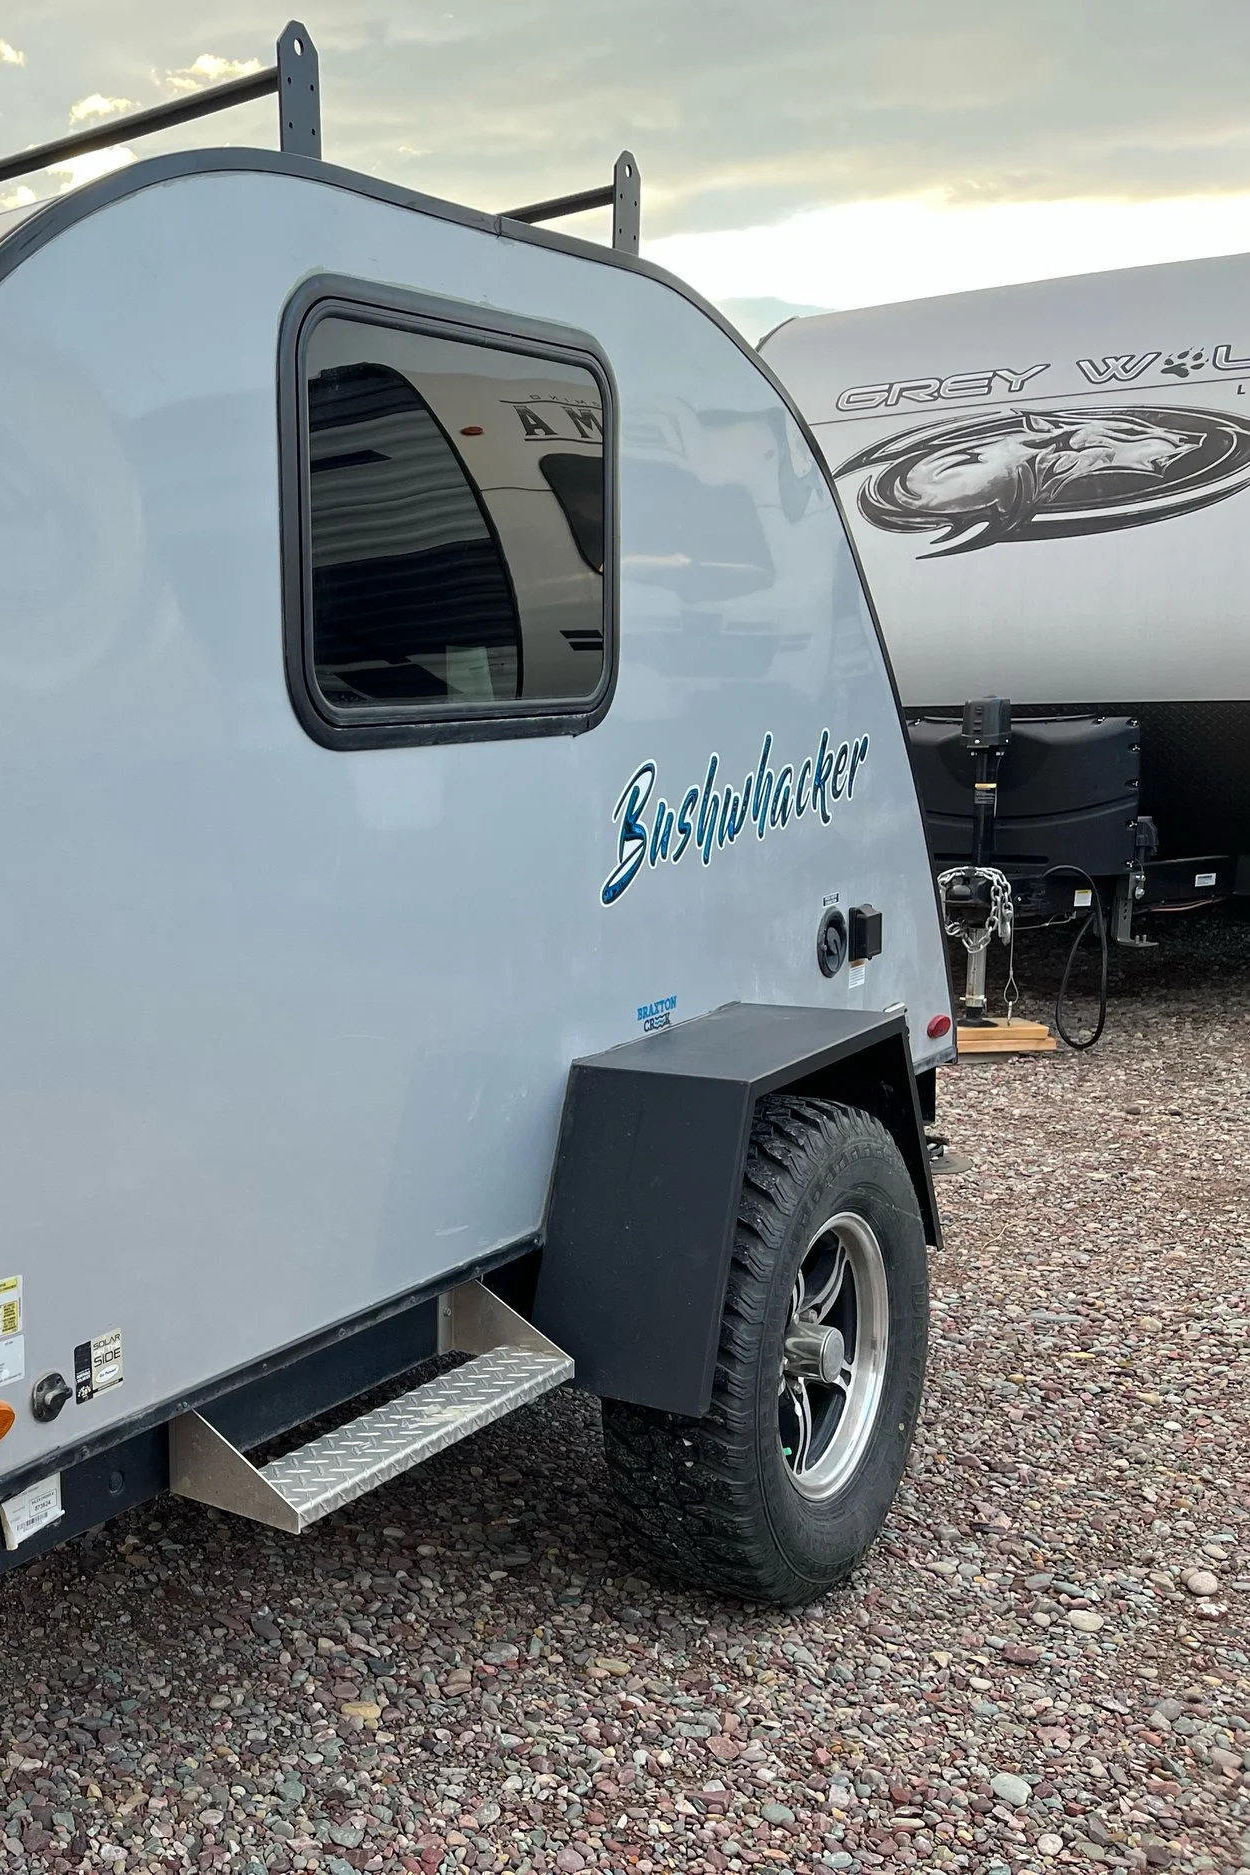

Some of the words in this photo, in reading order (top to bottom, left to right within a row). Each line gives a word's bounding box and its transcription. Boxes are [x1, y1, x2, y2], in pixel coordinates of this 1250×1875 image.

[836, 363, 1051, 412] GREY
[600, 727, 870, 908] Bushwhacker
[637, 995, 677, 1021] BRAXTON
[93, 1333, 121, 1351] SOLAR
[93, 1346, 121, 1368] SIDE
